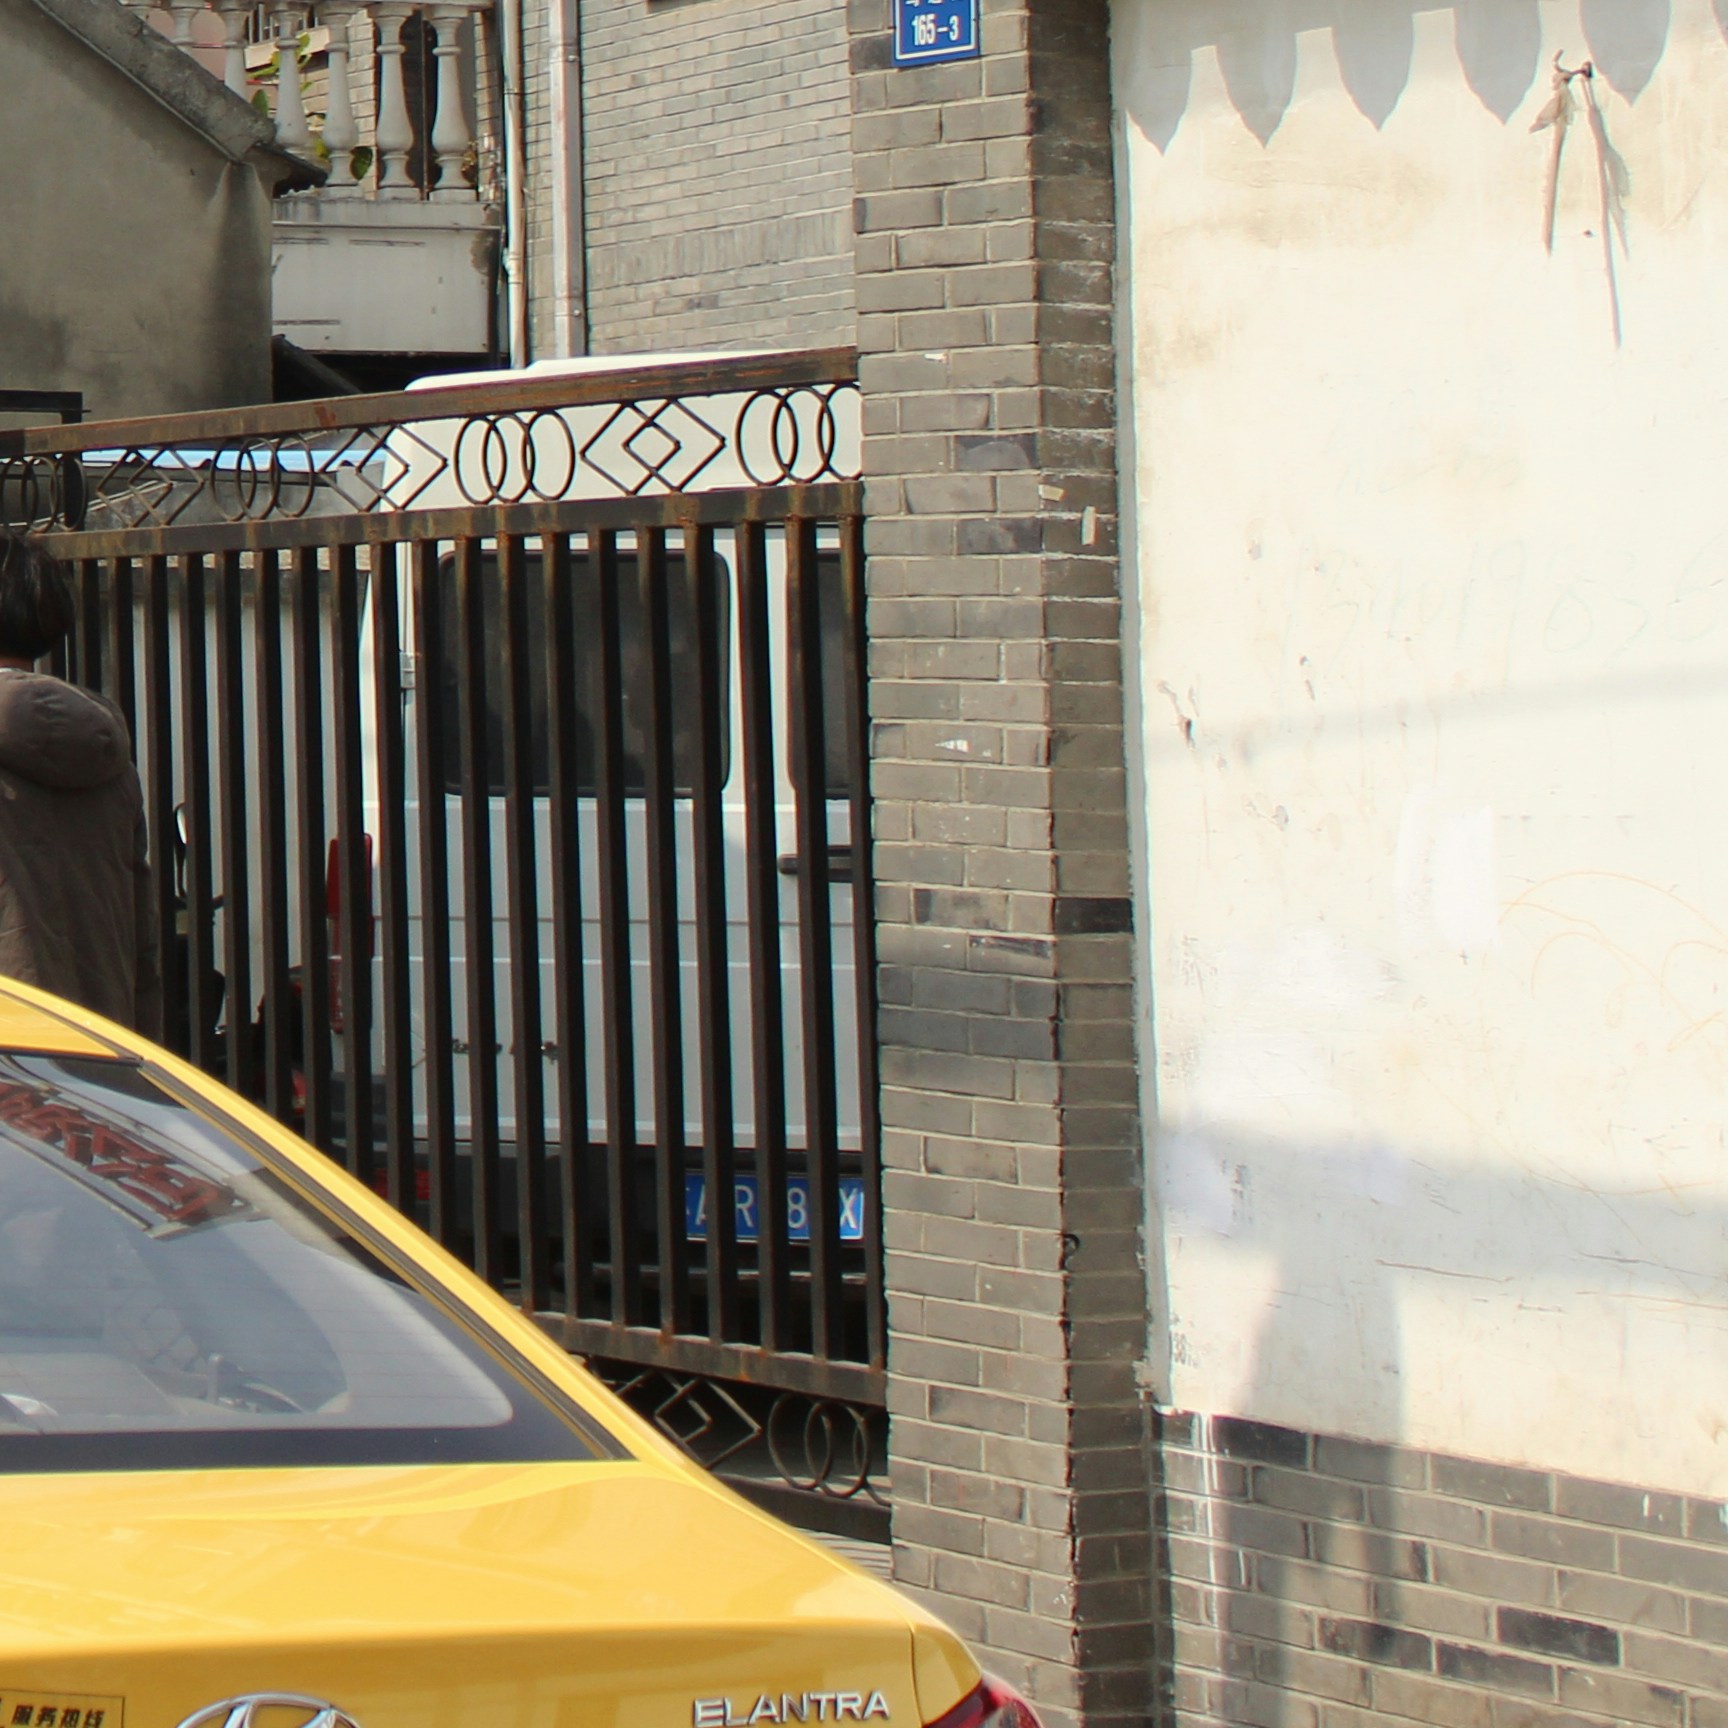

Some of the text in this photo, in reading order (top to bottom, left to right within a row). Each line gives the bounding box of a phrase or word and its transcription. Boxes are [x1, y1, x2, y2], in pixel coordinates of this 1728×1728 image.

[911, 12, 960, 46] 165-3
[11, 1704, 105, 1728] 服务热线
[692, 1690, 890, 1728] ELANTRA
